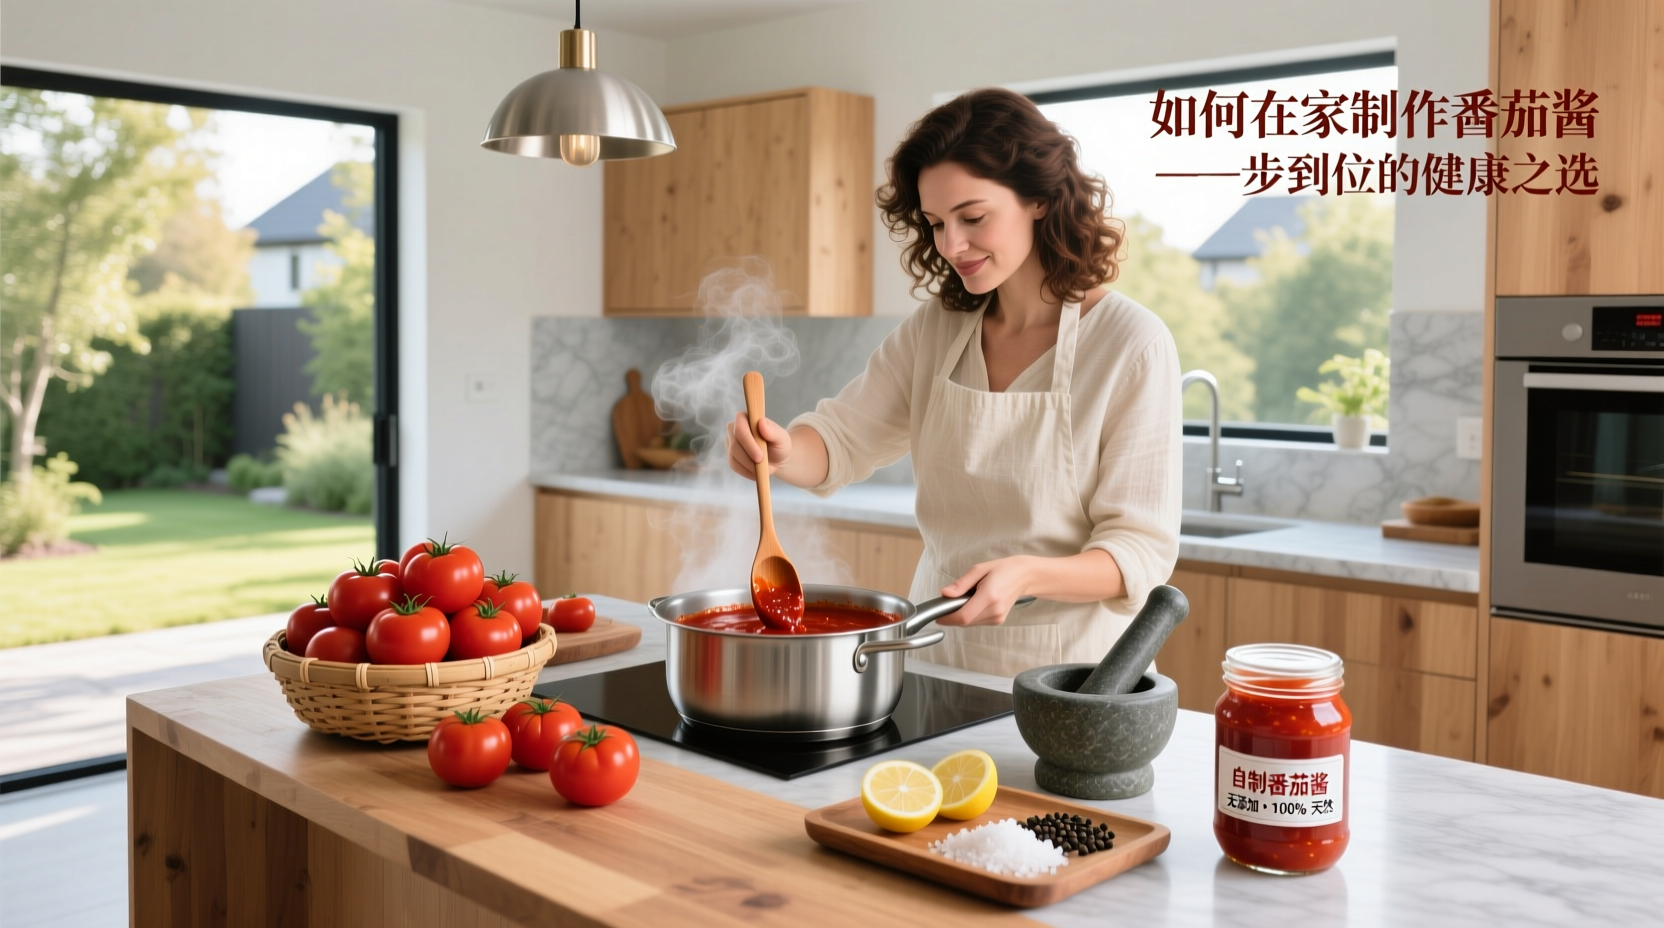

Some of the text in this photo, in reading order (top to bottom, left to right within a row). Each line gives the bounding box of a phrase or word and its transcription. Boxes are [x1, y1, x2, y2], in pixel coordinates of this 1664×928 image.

[1233, 766, 1329, 796] 自制番茄酱
[1272, 803, 1307, 815] 100%
